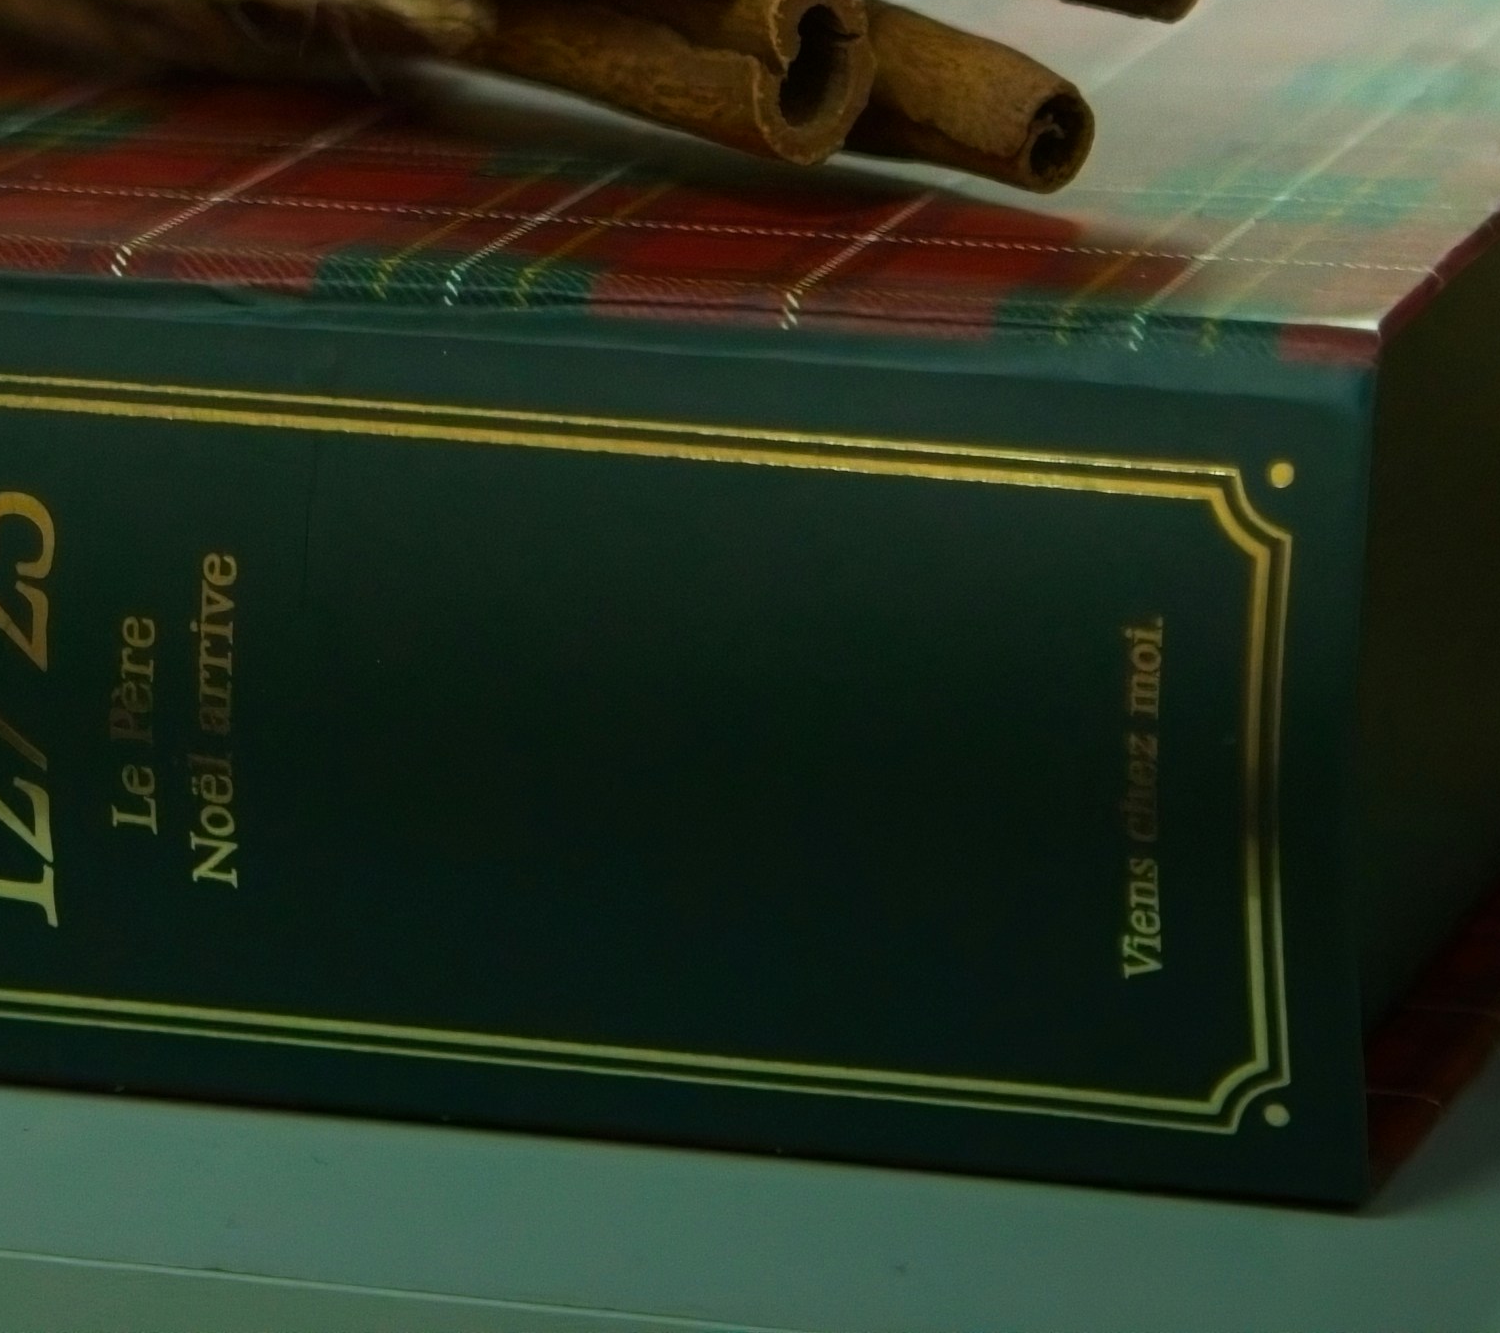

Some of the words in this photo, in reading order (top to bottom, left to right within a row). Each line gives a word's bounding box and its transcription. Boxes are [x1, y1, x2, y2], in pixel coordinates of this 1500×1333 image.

[109, 615, 156, 745] Père
[189, 551, 239, 736] arrive
[111, 762, 159, 835] Le
[188, 752, 239, 890] Noël
[1121, 732, 1158, 843] chez
[1122, 856, 1164, 980] Viens
